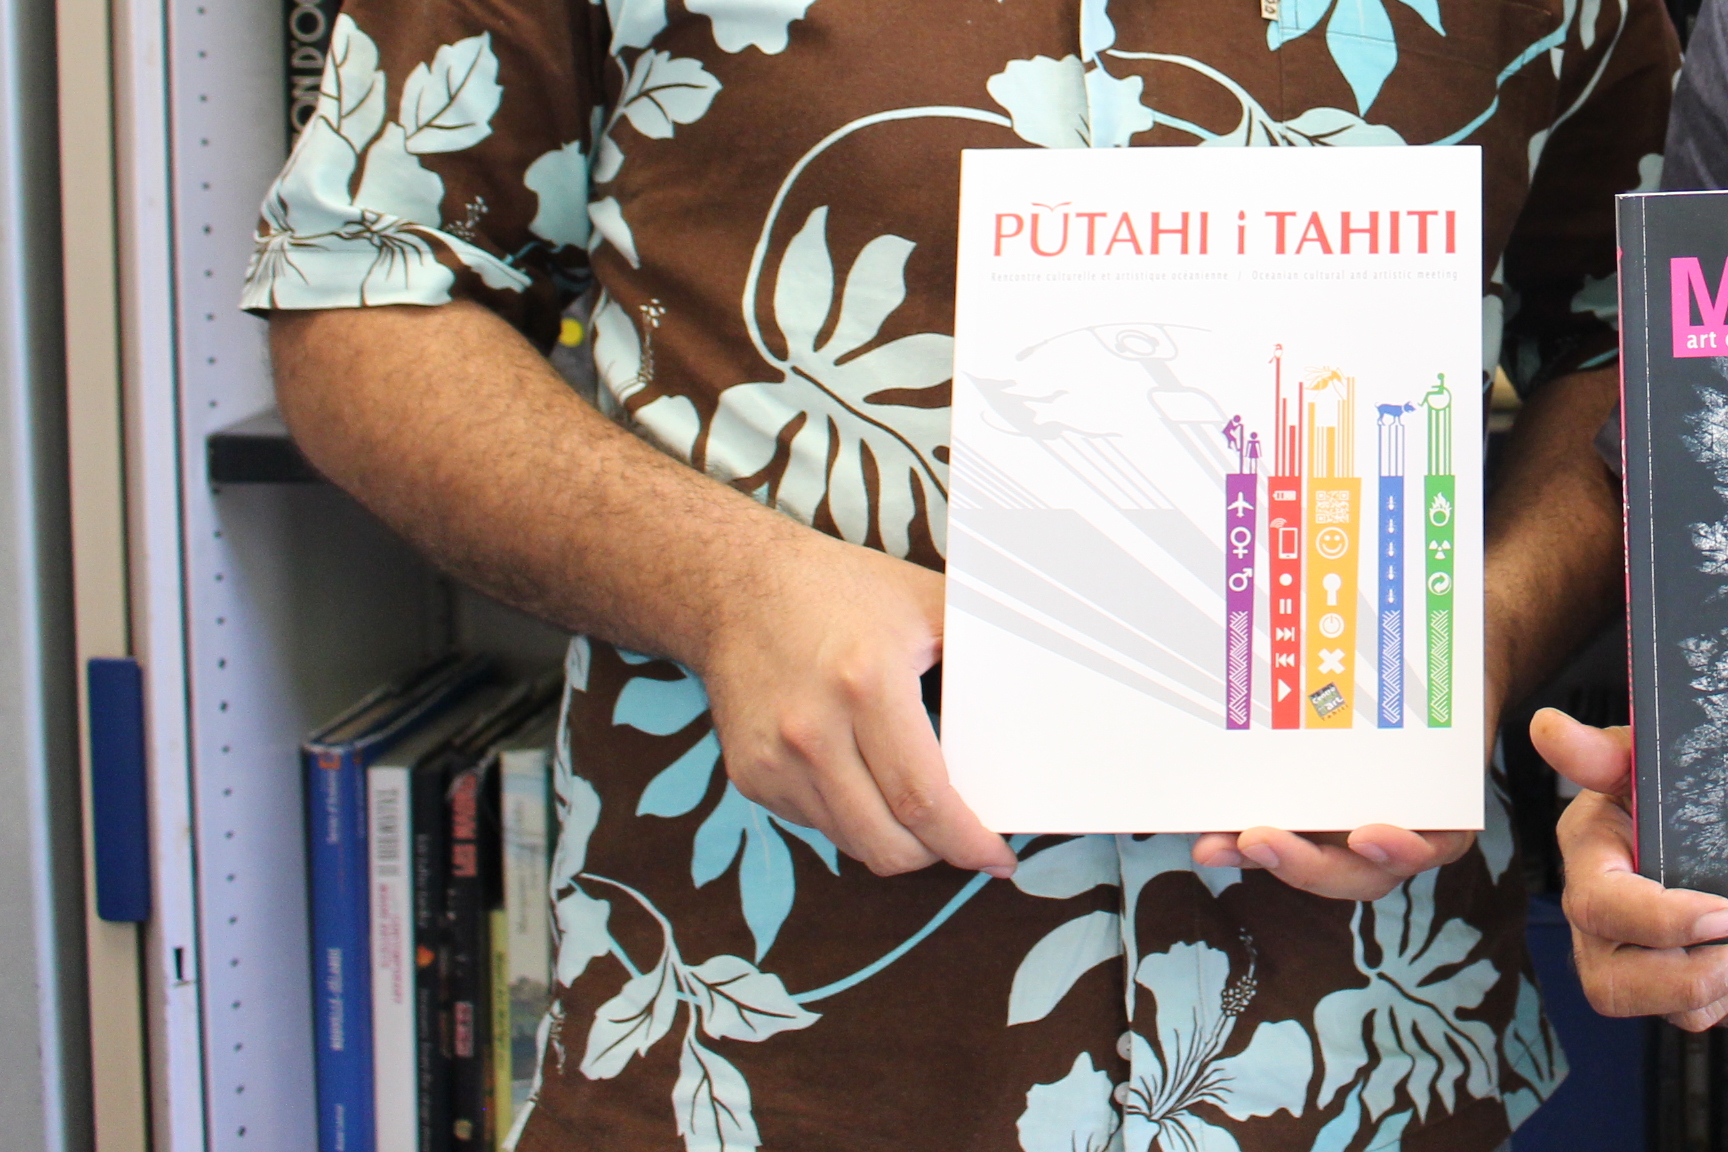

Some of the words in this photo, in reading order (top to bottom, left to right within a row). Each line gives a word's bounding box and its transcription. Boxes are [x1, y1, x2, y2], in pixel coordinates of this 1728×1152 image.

[1265, 209, 1458, 255] TAHITI
[990, 272, 1041, 282] Rencontre
[1046, 271, 1096, 281] culturelle
[1101, 272, 1110, 281] et
[1115, 270, 1166, 282] artistique
[1171, 269, 1228, 280] océanienne
[1251, 269, 1299, 280] Oceanian
[1303, 268, 1346, 280] cultural
[1349, 269, 1368, 280] and
[1372, 268, 1412, 280] artistic
[1417, 268, 1458, 281] meeting
[1685, 329, 1717, 350] art
